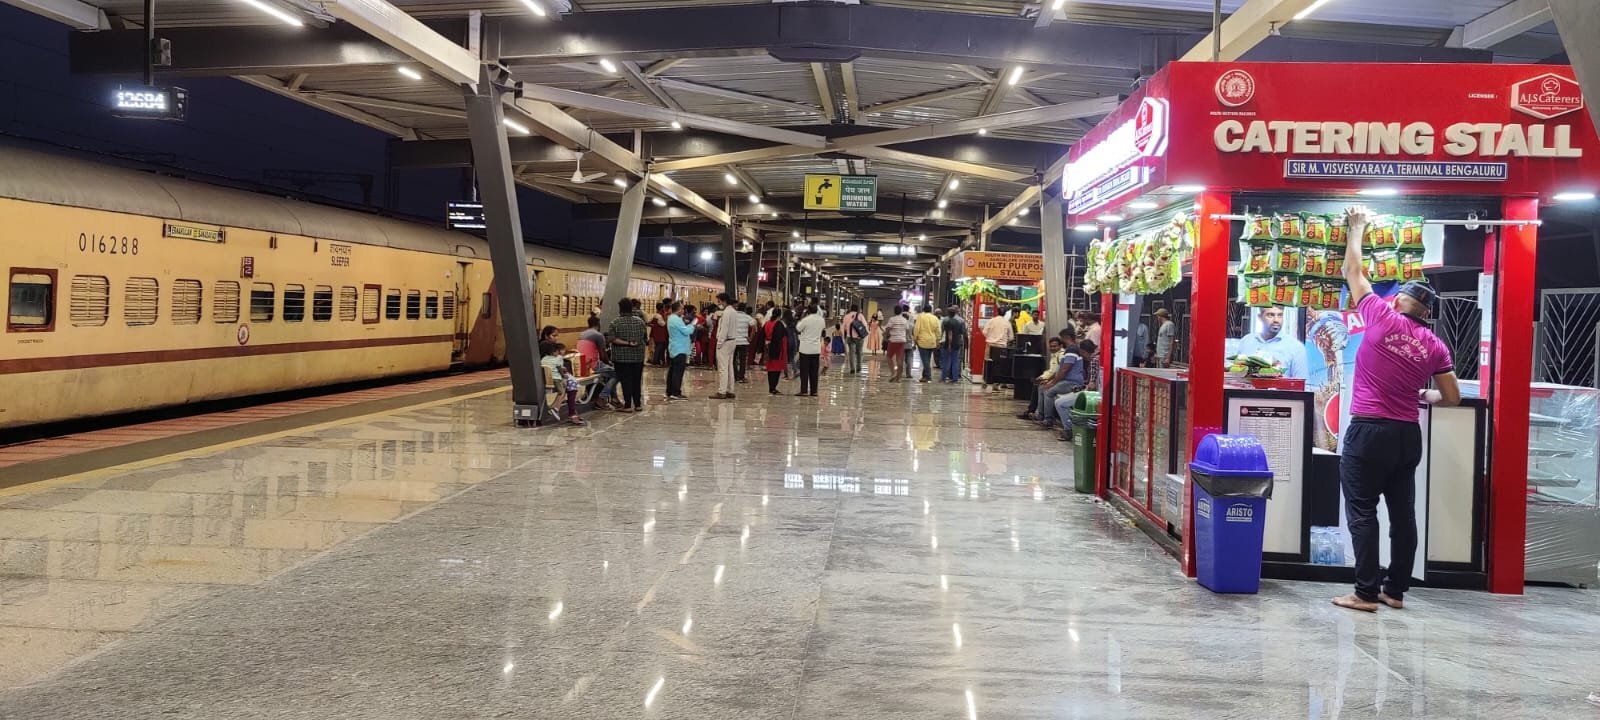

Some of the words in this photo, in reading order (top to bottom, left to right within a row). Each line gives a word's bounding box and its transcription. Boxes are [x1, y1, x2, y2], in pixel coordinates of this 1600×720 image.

[1539, 94, 1580, 104] Caterers
[1214, 120, 1435, 155] CATERING
[1443, 122, 1583, 157] STALL
[1292, 163, 1306, 174] SIR
[1308, 163, 1320, 174] M.
[1323, 163, 1394, 175] VISVESVARAYA
[1397, 164, 1443, 176] TERMINAL
[1445, 165, 1503, 177] BENGALURU
[856, 187, 870, 195] जल
[842, 194, 873, 202] DRINKING
[79, 232, 139, 255] 016288
[331, 256, 350, 267] SLEEPER
[1226, 507, 1253, 517] ARISTO
